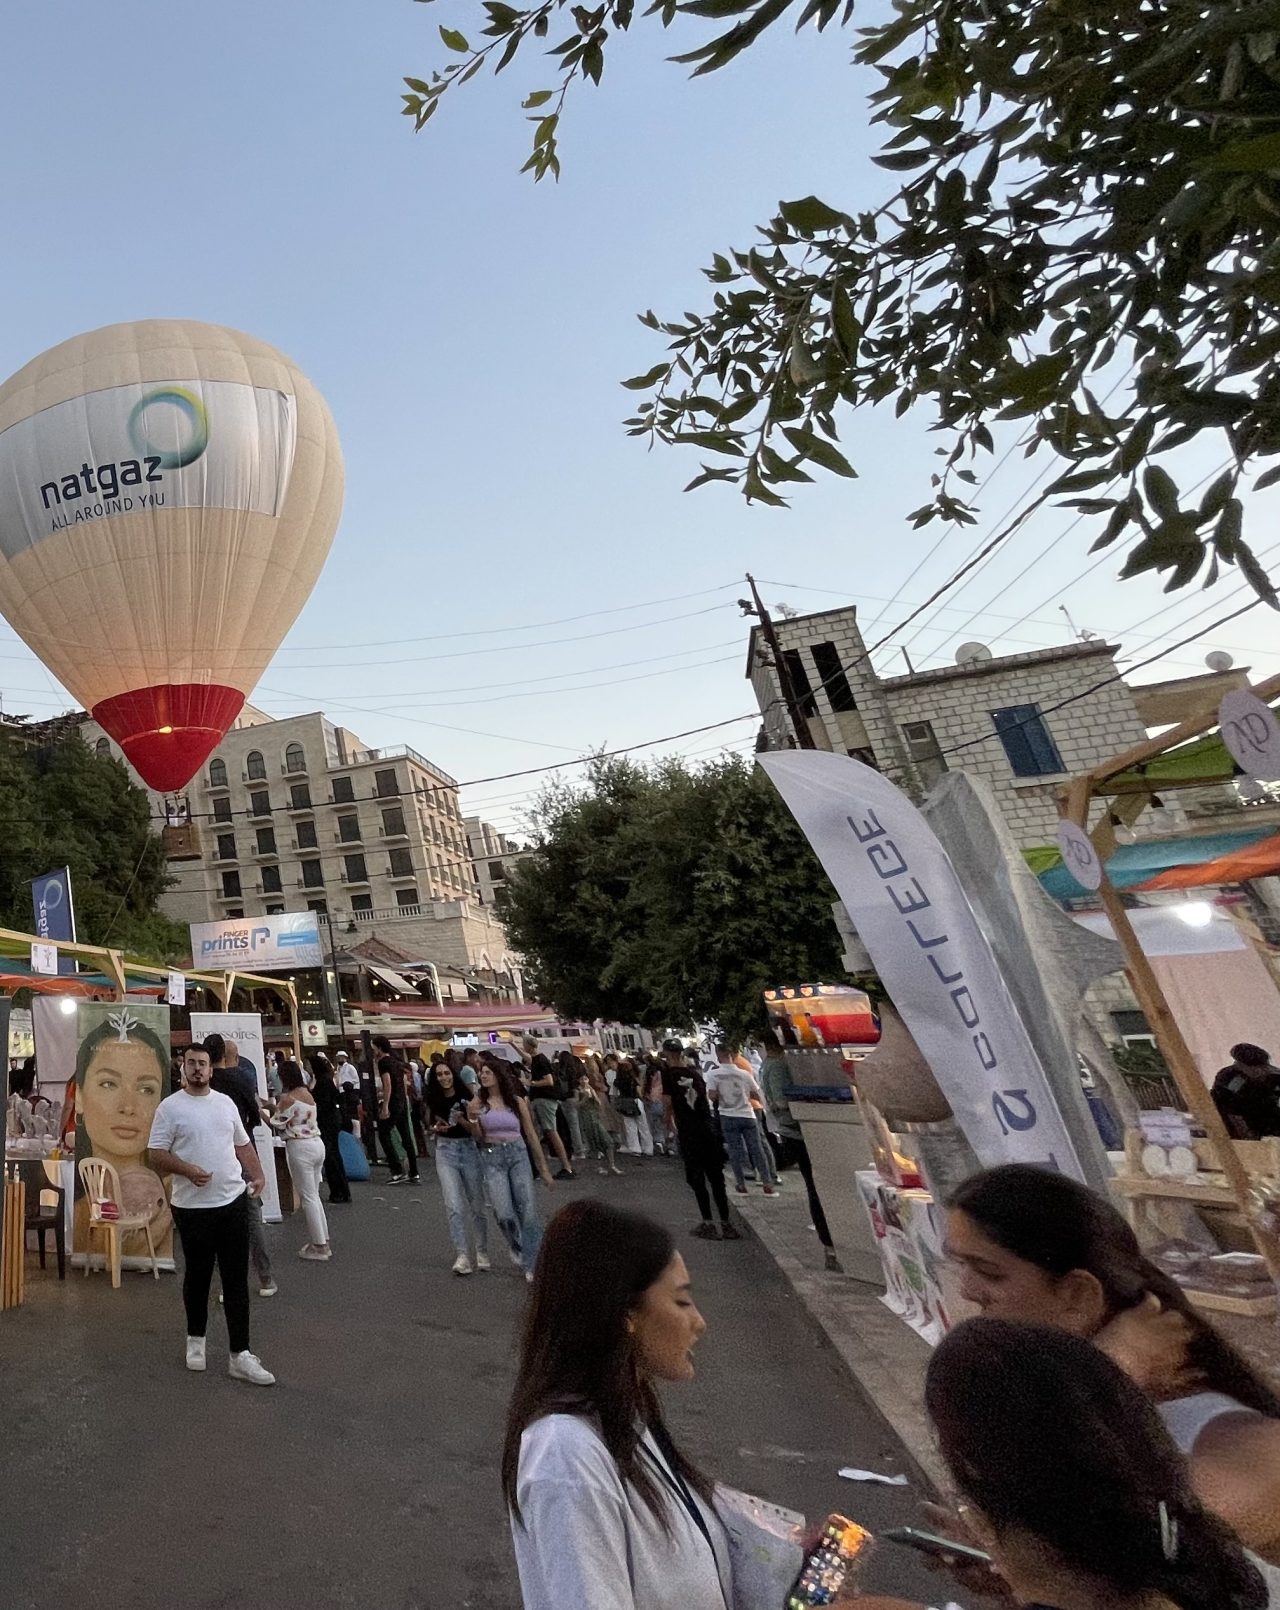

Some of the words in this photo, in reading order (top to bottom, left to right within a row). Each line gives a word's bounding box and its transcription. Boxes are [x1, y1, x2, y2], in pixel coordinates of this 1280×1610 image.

[40, 456, 163, 509] natgaz
[52, 514, 73, 531] ALL
[139, 493, 165, 509] YOU
[201, 935, 249, 956] prints
[223, 929, 249, 937] FINGER
